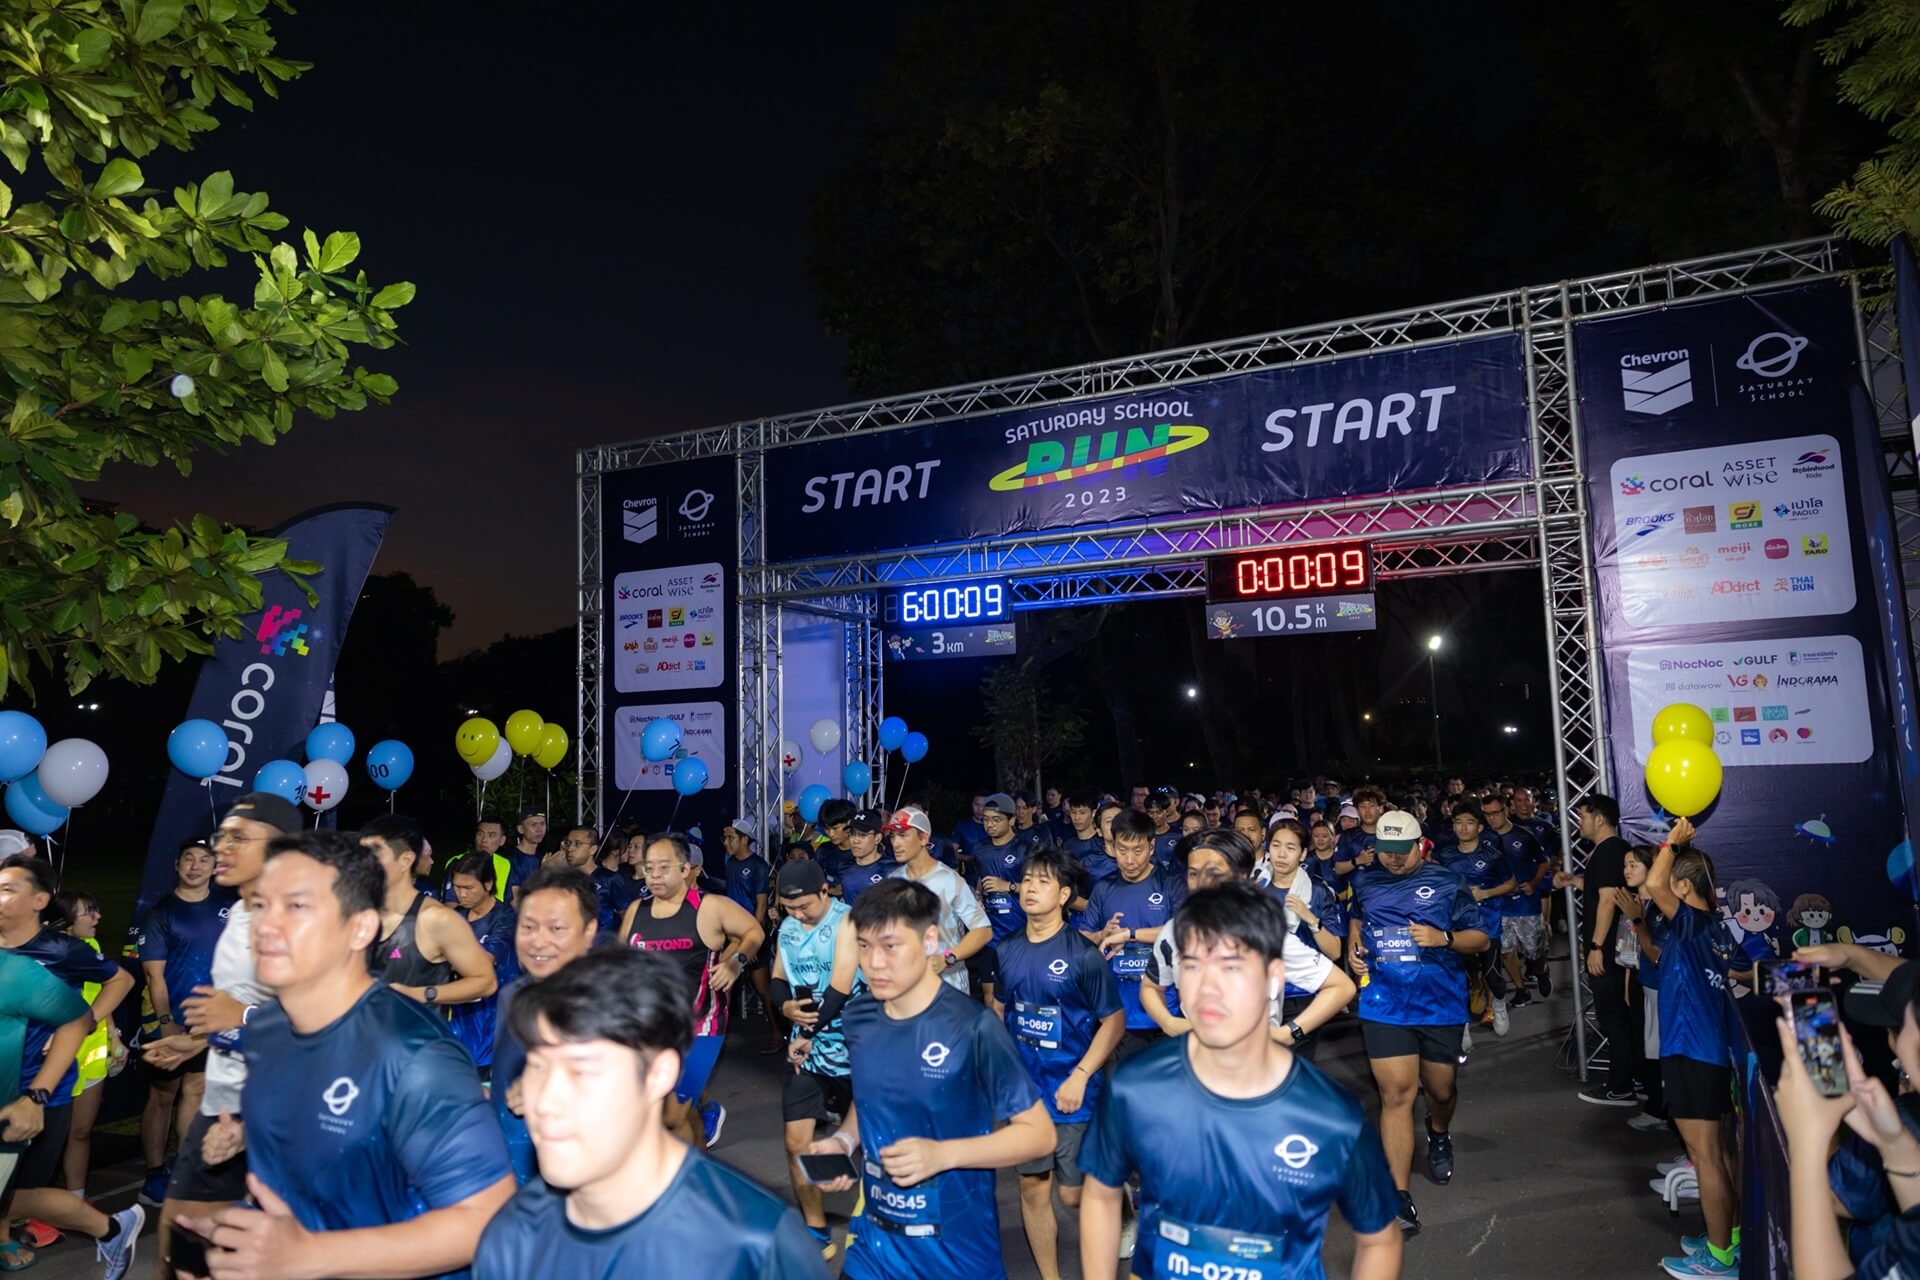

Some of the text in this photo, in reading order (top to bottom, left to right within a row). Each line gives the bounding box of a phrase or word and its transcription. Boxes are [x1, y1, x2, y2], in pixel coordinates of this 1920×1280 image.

[1620, 348, 1690, 368] Chevron
[1738, 376, 1815, 394] SATURDAY
[1750, 389, 1806, 403] SCHOOL
[1004, 401, 1194, 445] SATURDAY SCHOOL
[1261, 385, 1457, 452] START
[1022, 423, 1172, 493] RUN
[1722, 457, 1777, 473] ASSET
[1792, 463, 1835, 474] Robinhood
[801, 459, 941, 514] START
[1650, 470, 1714, 493] coral
[623, 497, 658, 509] Chevron
[1065, 486, 1127, 508] 2023
[1626, 511, 1676, 526] BROOKS
[1792, 507, 1820, 518] PAOLO
[1718, 542, 1752, 556] meiji
[1803, 547, 1829, 557] TARO
[1238, 550, 1365, 594] 0:00:09
[1790, 575, 1814, 584] THAI
[667, 576, 694, 587] ASSET
[1792, 583, 1815, 592] RUN
[632, 584, 664, 599] coral
[903, 584, 1003, 623] 6:00:09
[1251, 604, 1312, 632] 10.5
[931, 632, 945, 654] 3
[1673, 658, 1724, 670] NocNoc
[1744, 654, 1779, 666] GULF
[1776, 674, 1839, 687] INDORAMA
[637, 938, 695, 951] BEYOND
